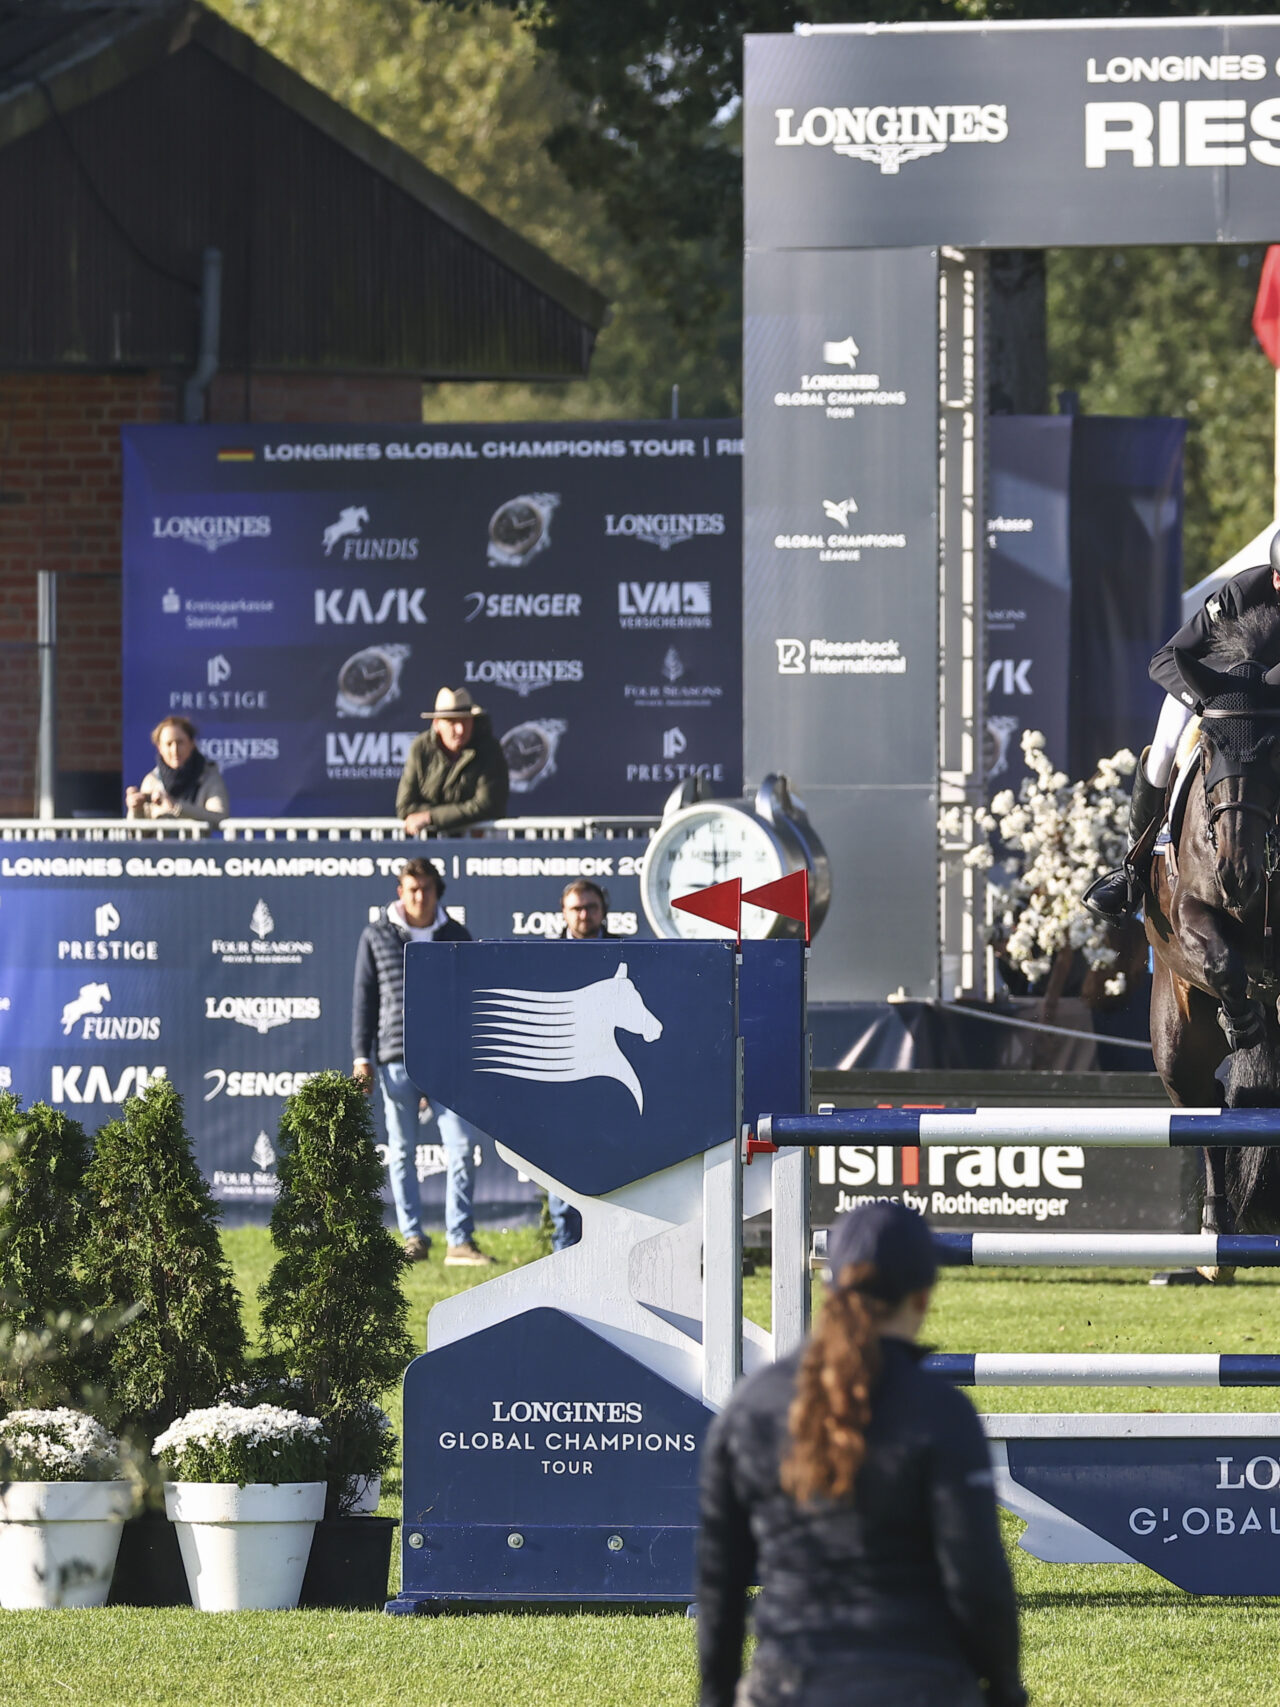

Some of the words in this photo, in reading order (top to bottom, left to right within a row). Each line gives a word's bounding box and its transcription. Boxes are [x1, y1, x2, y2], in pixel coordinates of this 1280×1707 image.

[1086, 54, 1266, 84] LONGINES
[774, 104, 1009, 147] LONGINES
[801, 374, 880, 390] LONGINES
[774, 391, 826, 406] GLOBAL
[827, 391, 907, 406] CHAMPIONS
[826, 406, 855, 419] TOUR
[264, 444, 382, 462] LONGINES
[384, 441, 479, 460] GLOBAL
[481, 439, 627, 460] CHAMPIONS
[630, 438, 696, 457] TOUR
[153, 516, 271, 538] LONGINES
[605, 514, 726, 536] LONGINES
[343, 538, 420, 561] FUNDIS
[774, 534, 826, 549] GLOBAL
[827, 533, 907, 549] CHAMPIONS
[819, 549, 861, 562] LEAGUE
[314, 588, 428, 625] KASK
[485, 593, 583, 618] SENGER
[618, 581, 680, 616] LVM
[619, 616, 713, 629] VERSICHERUNG
[810, 639, 900, 657] Riesenbeck
[464, 660, 584, 682] LONGINES
[810, 656, 907, 675] International
[169, 690, 268, 710] PRESTIGE
[200, 737, 279, 760] GINES
[326, 733, 391, 766] LVM
[326, 766, 404, 780] VERSICHERU
[1, 857, 124, 877] LONGINES
[125, 857, 223, 877] GLOBAL
[224, 857, 375, 877] CHAMPIONS
[376, 857, 445, 877] TOR
[466, 857, 614, 877] RIESENBECK
[513, 911, 638, 935] LONES
[58, 940, 159, 960] PRESTIGE
[211, 938, 250, 954] FOUR
[205, 996, 321, 1020] LONGINES
[82, 1016, 161, 1040] FUNDIS
[225, 1071, 320, 1097] SENGE
[903, 1190, 929, 1216] by
[931, 1191, 1069, 1221] Rothenberger
[492, 1401, 643, 1423] LONGINES
[439, 1432, 535, 1451] GLOBAL
[545, 1432, 696, 1452] CHAMPIONS
[541, 1460, 594, 1474] TOUR
